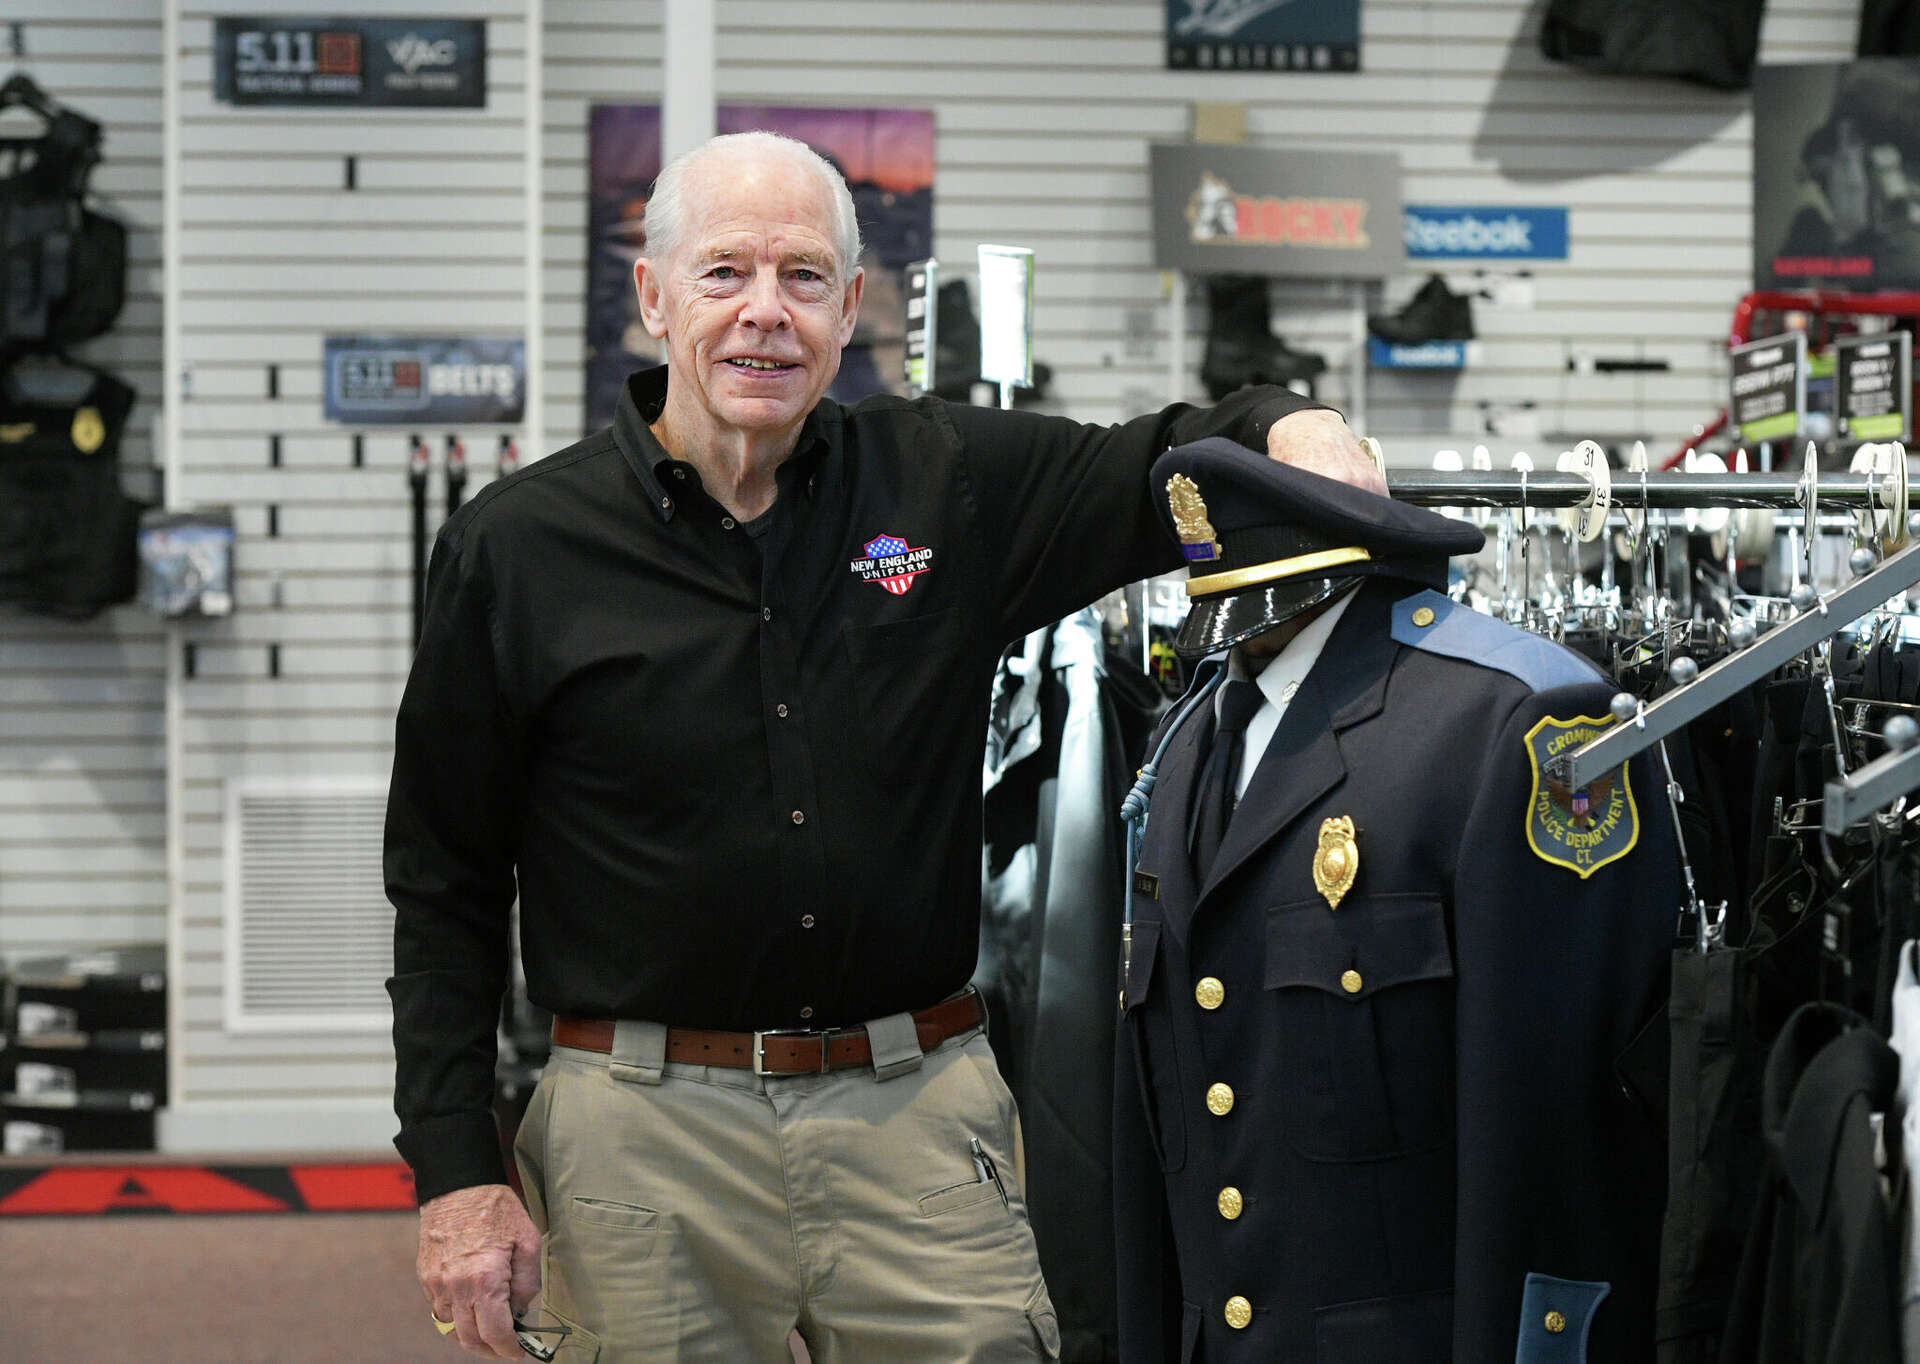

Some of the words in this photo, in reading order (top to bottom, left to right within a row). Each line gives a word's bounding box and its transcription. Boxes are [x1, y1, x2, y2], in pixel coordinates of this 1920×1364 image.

[236, 31, 317, 72] 5.11
[1236, 201, 1363, 241] ROCKY
[1584, 447, 1594, 468] 31
[851, 560, 875, 573] NEW
[879, 548, 933, 569] ENGLAND
[862, 561, 928, 579] UNIFORM
[1546, 728, 1601, 756] CROMW
[1537, 791, 1565, 841] POLICE
[1566, 788, 1624, 849] DEPARTMENT
